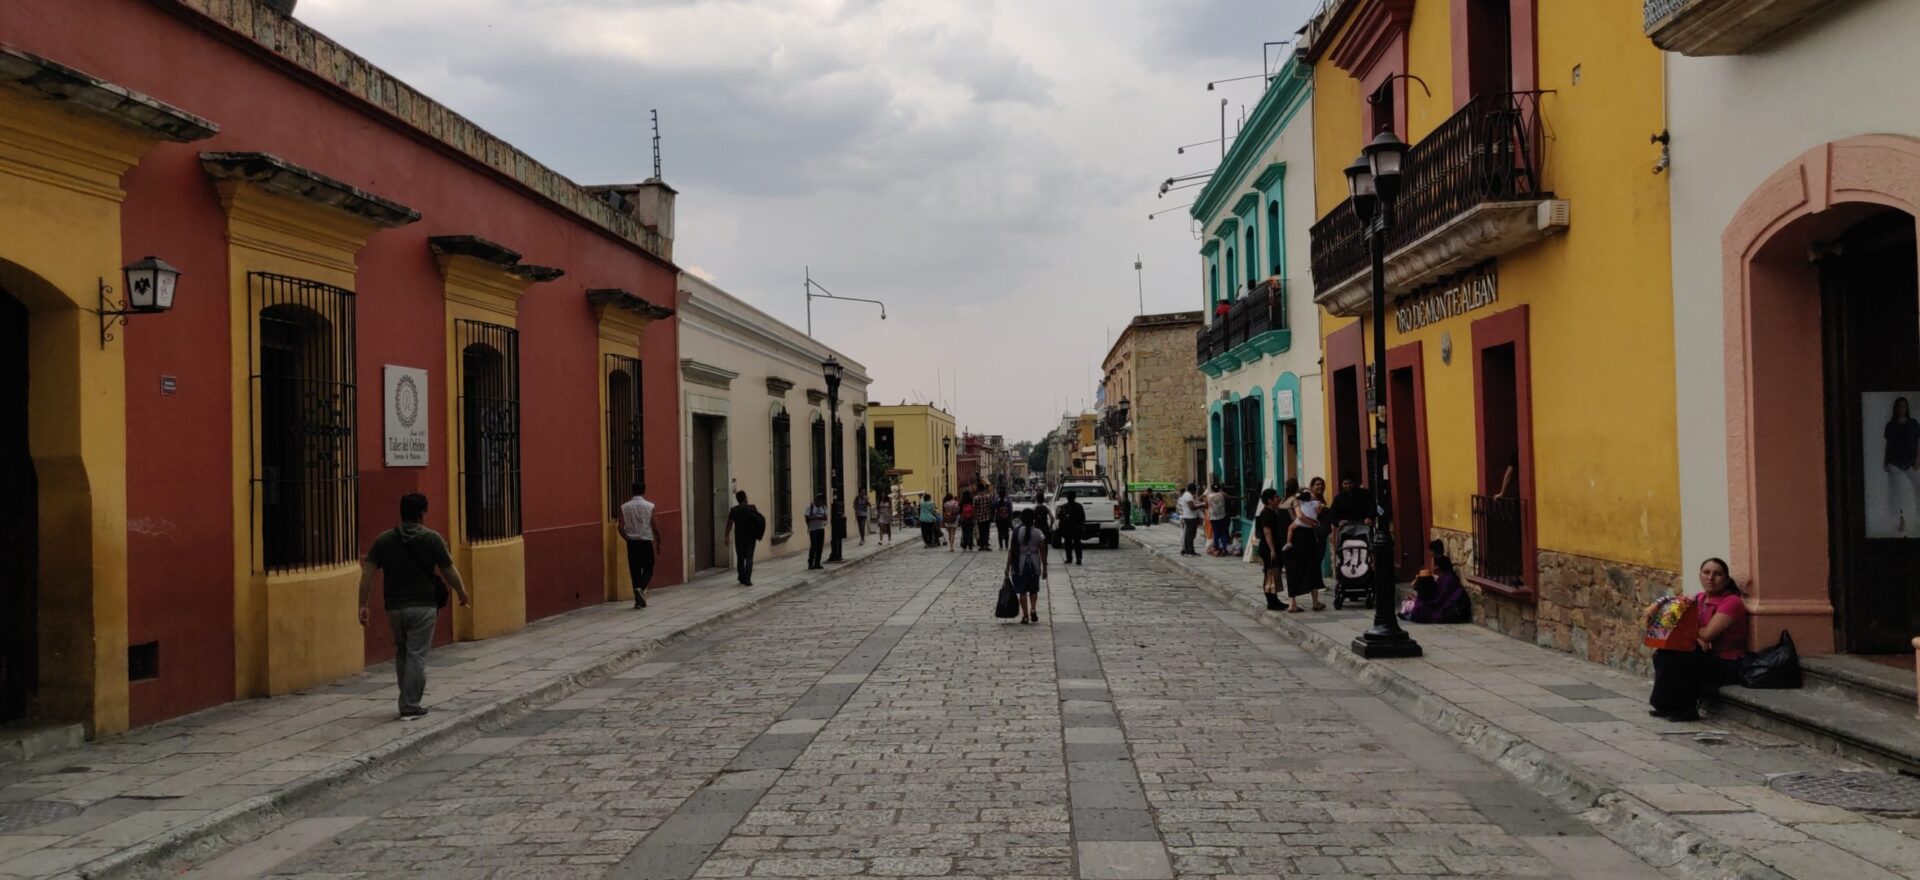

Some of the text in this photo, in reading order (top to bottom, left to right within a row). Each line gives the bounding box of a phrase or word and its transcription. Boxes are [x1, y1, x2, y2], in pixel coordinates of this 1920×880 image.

[1395, 308, 1412, 332] ORO
[1413, 301, 1425, 328] DE
[1426, 288, 1460, 324] MONTE
